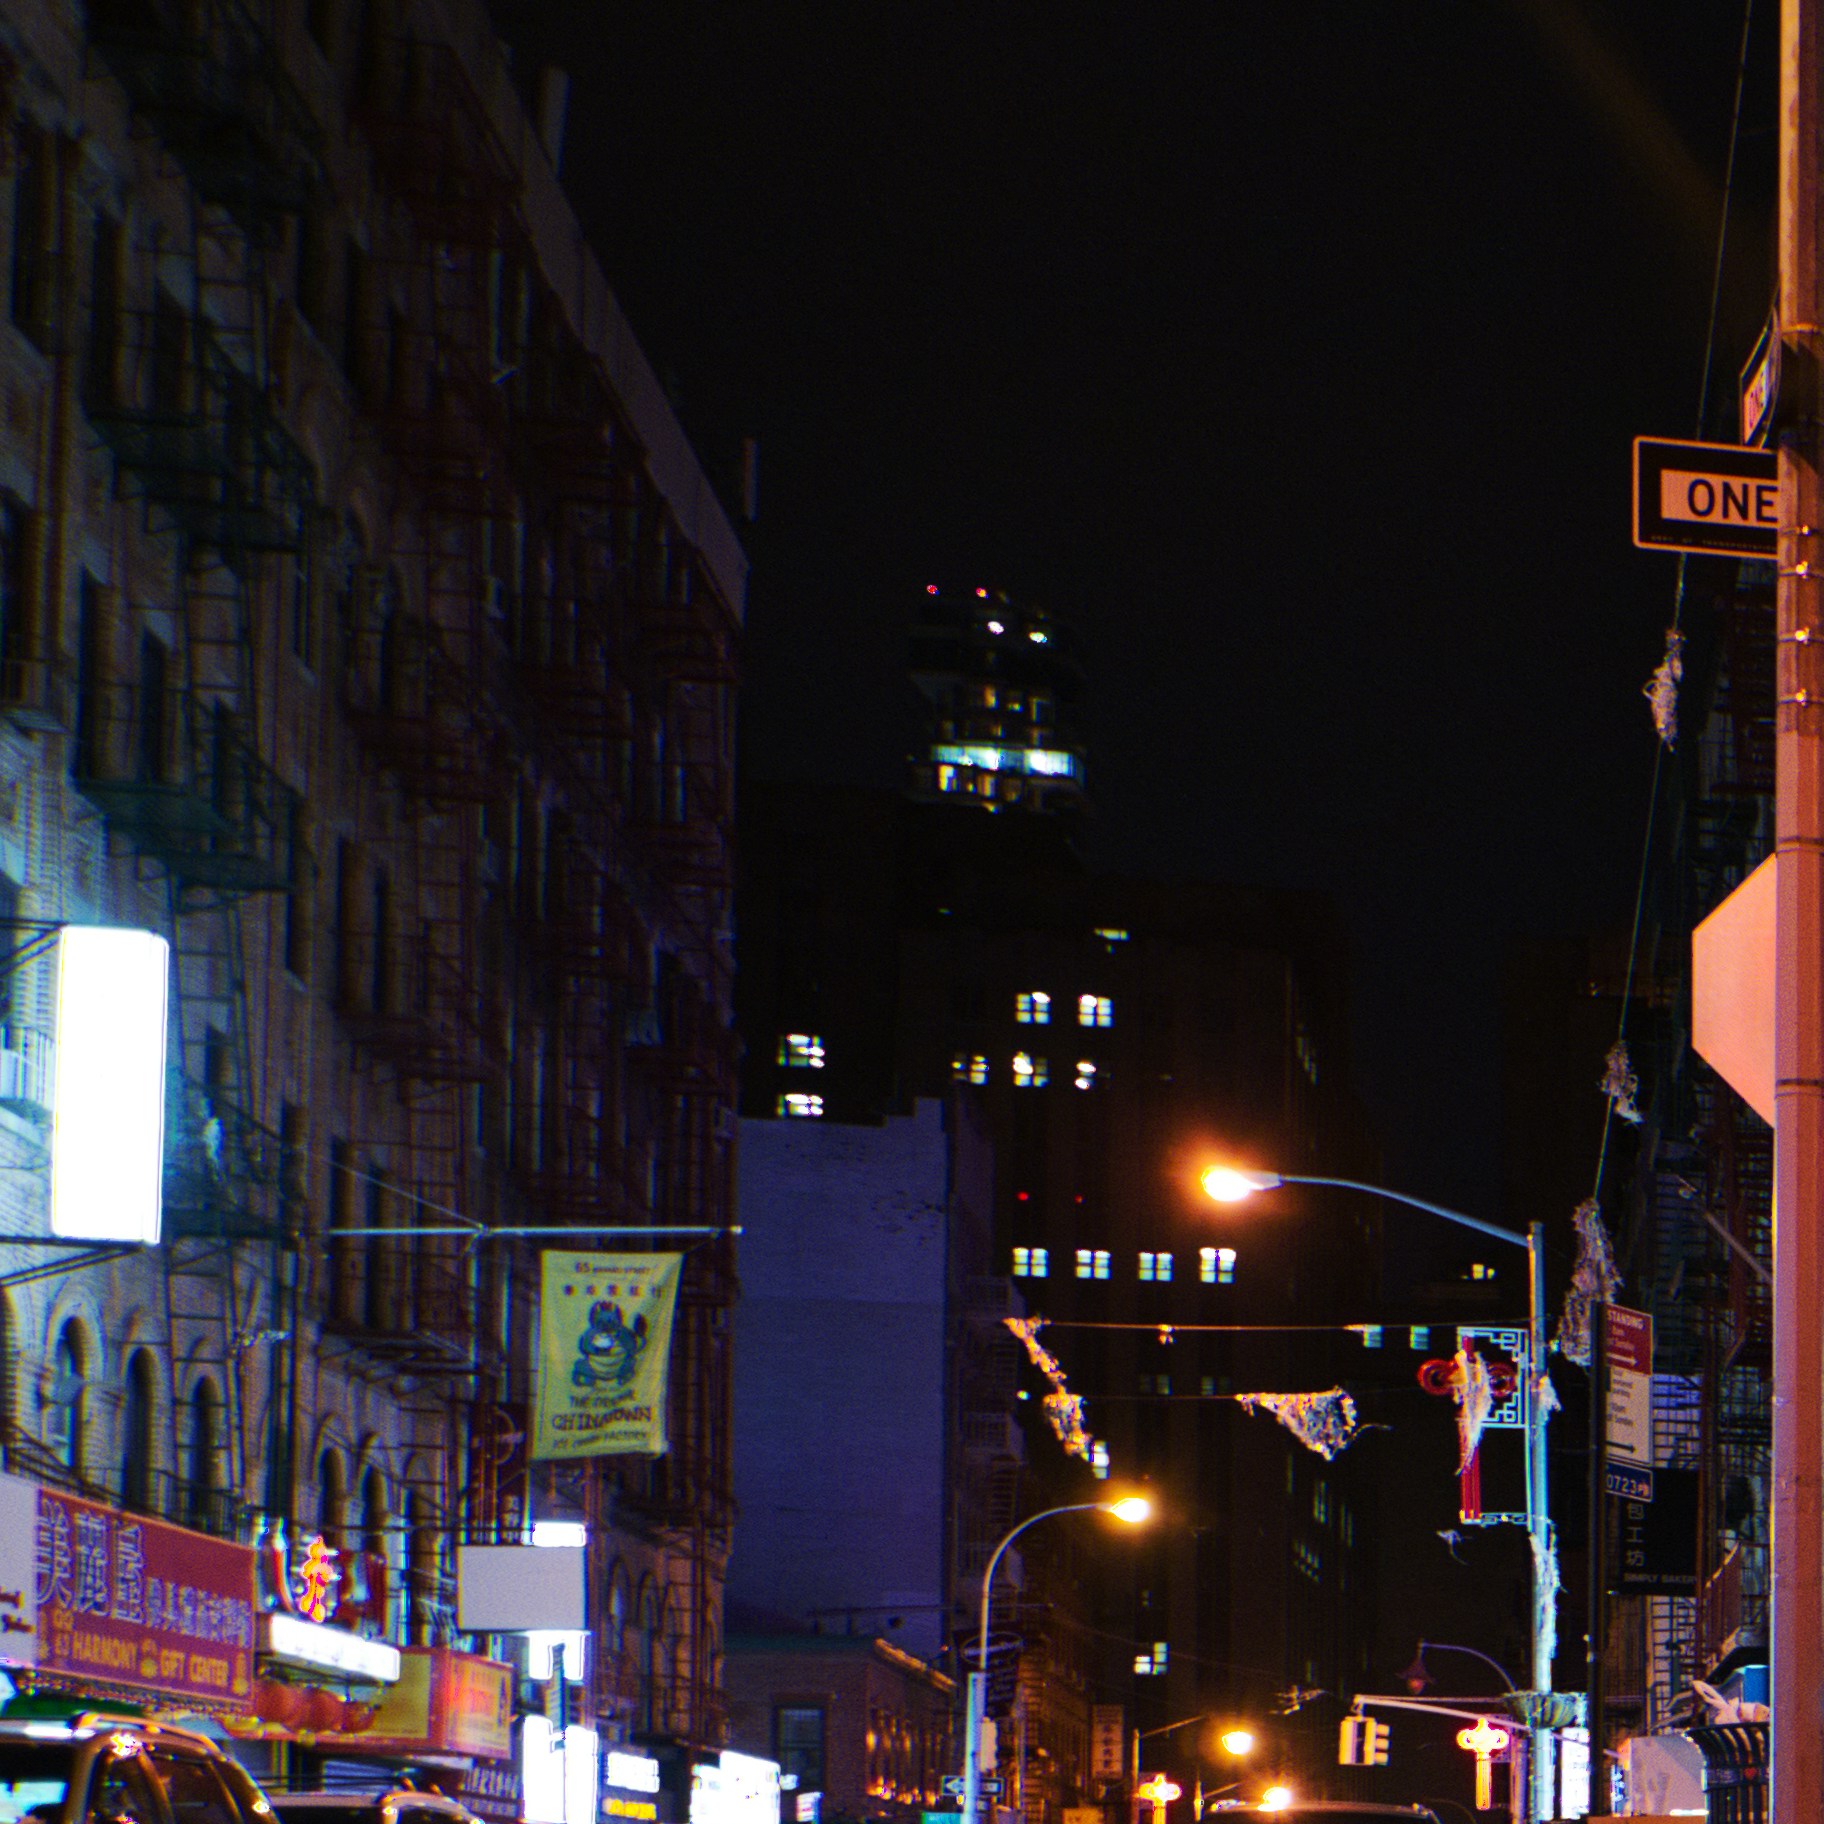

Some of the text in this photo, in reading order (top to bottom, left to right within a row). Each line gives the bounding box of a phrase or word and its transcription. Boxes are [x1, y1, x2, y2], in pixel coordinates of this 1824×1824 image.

[1687, 478, 1778, 524] ONE
[551, 1405, 653, 1432] CHINATOWN
[160, 1648, 186, 1680] GIFT
[188, 1653, 229, 1688] CENTER
